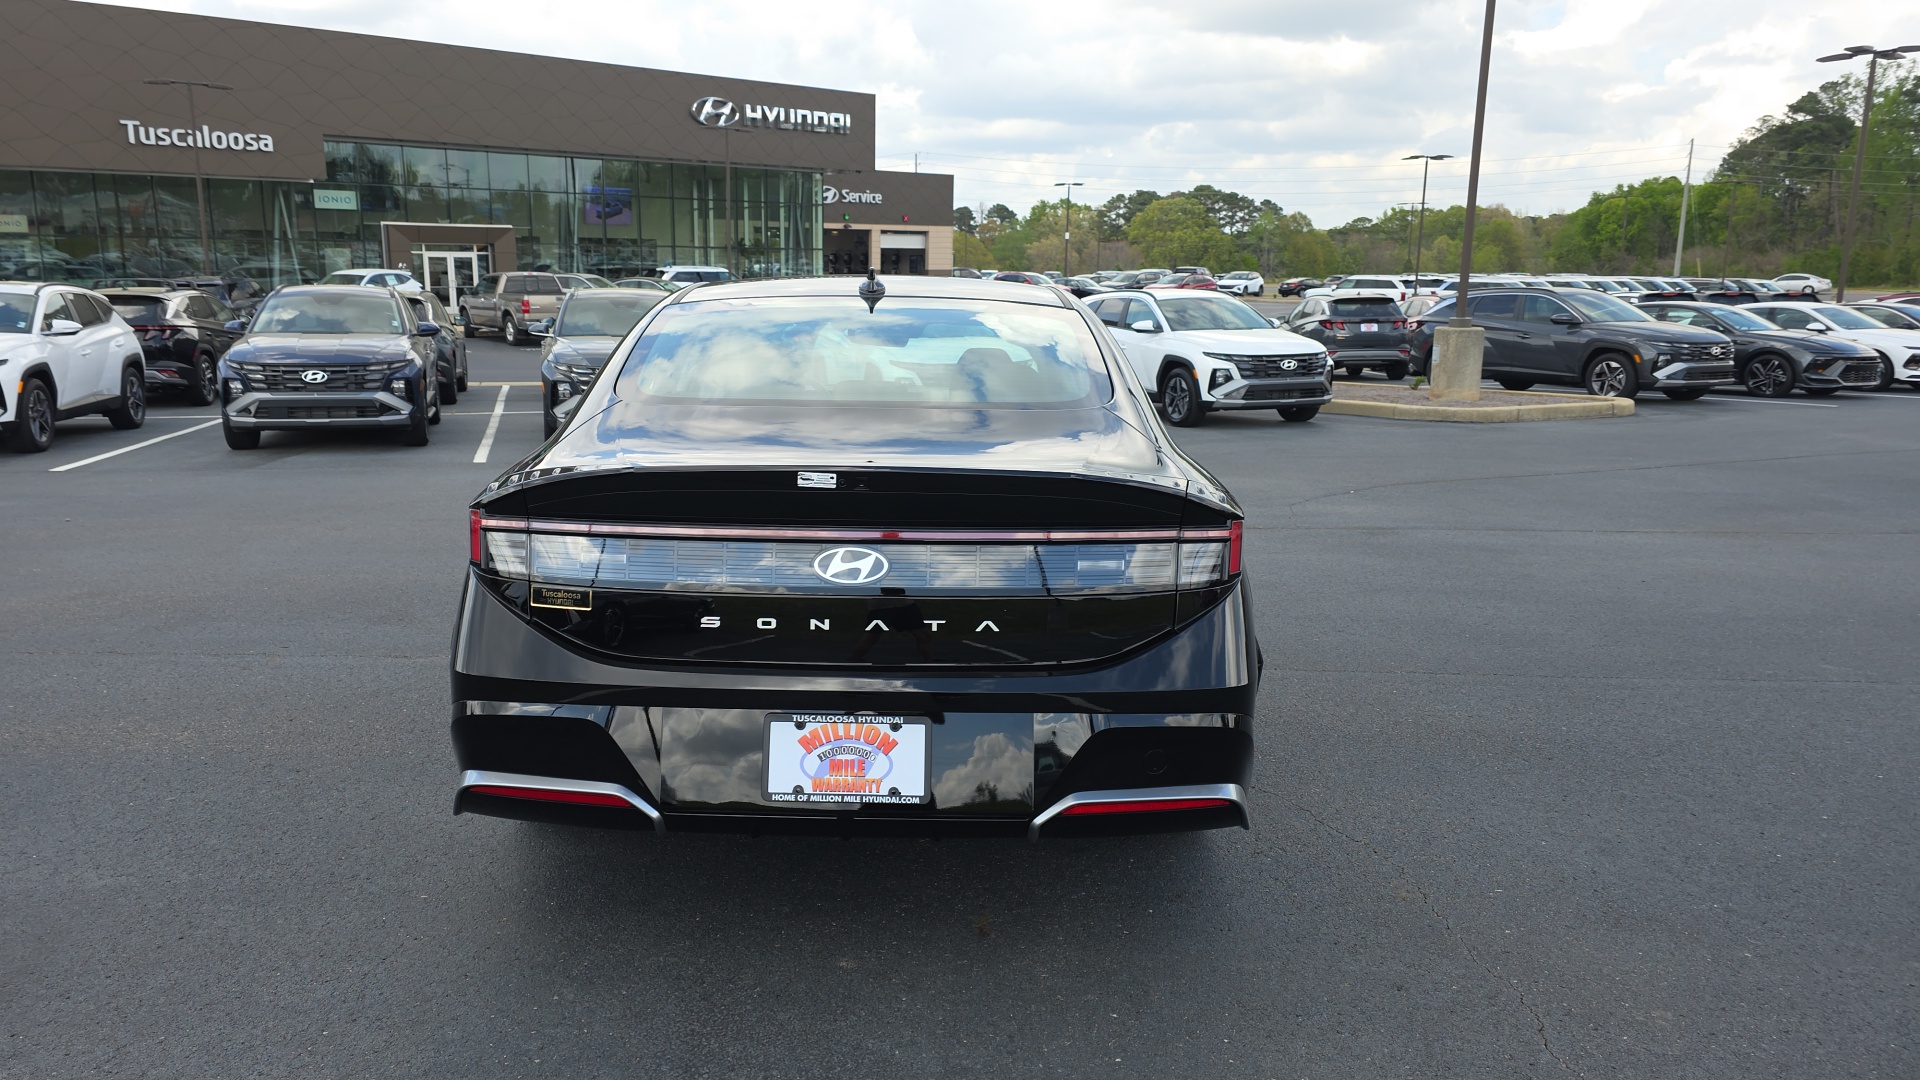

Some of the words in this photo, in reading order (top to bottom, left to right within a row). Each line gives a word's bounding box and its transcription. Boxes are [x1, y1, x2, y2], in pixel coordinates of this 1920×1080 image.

[744, 103, 851, 135] HYUNDAI
[119, 119, 274, 152] Tuscaloosa
[841, 189, 882, 204] Service
[541, 589, 581, 599] Tuscaloosa
[547, 598, 574, 606] HYUNDAI
[700, 616, 1000, 632] SONATA
[792, 714, 856, 723] TUSCALOOSA
[858, 715, 904, 724] HYUNDAI
[797, 722, 899, 756] MILLION
[828, 758, 866, 777] MILE
[811, 777, 883, 793] WARRANTY
[772, 794, 796, 802] HOME
[797, 794, 808, 802] OF
[810, 794, 842, 803] MILLION
[843, 795, 861, 803] MILE
[863, 795, 920, 804] HYUNDAI.COM
